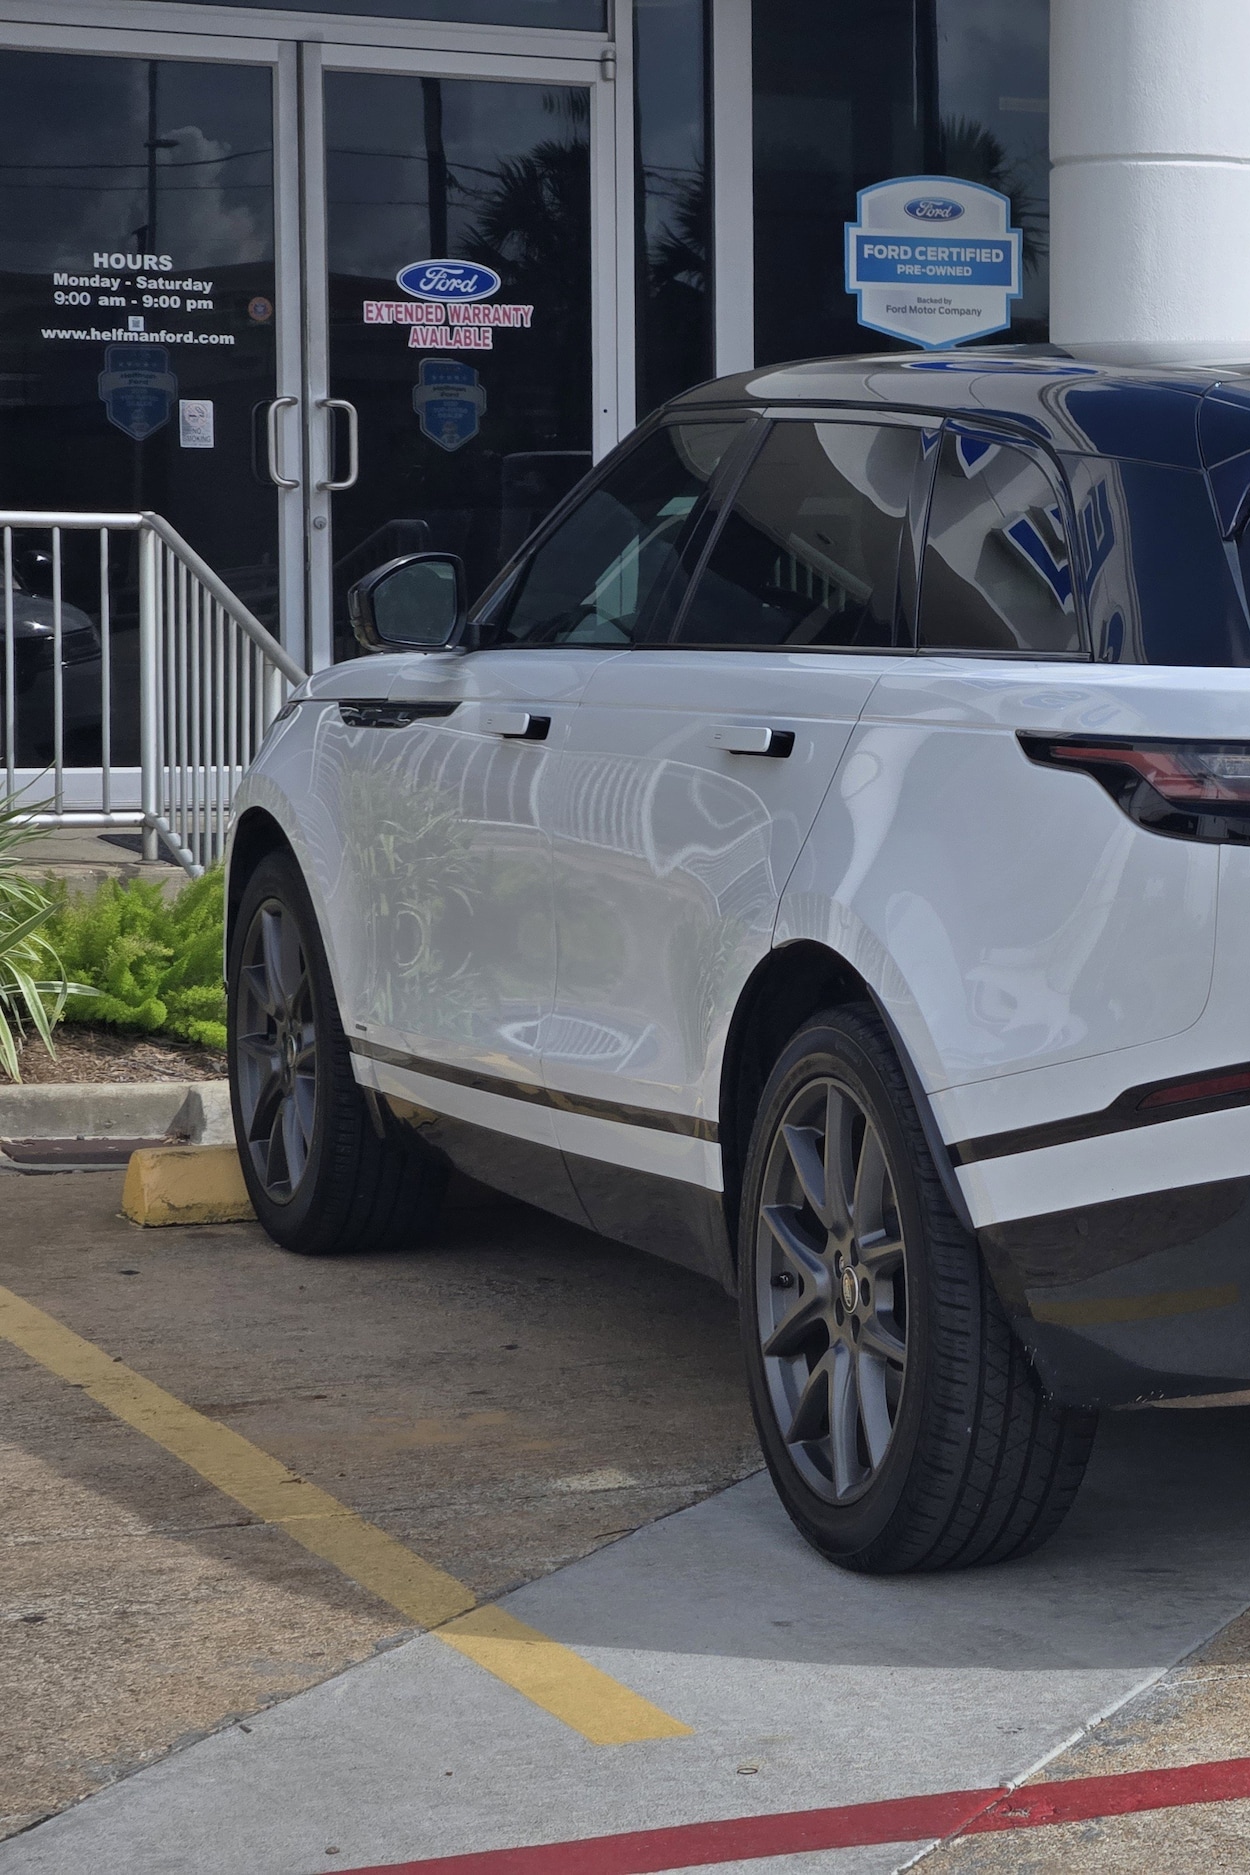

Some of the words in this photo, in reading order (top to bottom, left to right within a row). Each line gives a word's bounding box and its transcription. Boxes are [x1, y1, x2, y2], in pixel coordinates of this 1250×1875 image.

[915, 200, 953, 218] Ford
[93, 252, 173, 271] HOURS
[863, 244, 912, 260] FORD
[915, 246, 1004, 263] CERTIFIED
[419, 266, 478, 293] Ford
[897, 264, 972, 277] PRE-OWNED
[53, 273, 121, 291] Monday
[136, 275, 213, 294] Saturday
[53, 291, 91, 306] 9:00
[98, 295, 126, 307] am
[142, 294, 181, 309] 9:00
[186, 299, 213, 312] pm
[886, 304, 907, 315] Ford
[909, 305, 936, 316] Motor
[938, 306, 982, 317] Company
[917, 296, 942, 305] Backed
[943, 297, 952, 306] by
[364, 301, 445, 324] EXTENDED
[448, 304, 533, 327] WARRANTY
[41, 327, 235, 345] www.helfmanford.com
[408, 326, 492, 349] AVAILABLE
